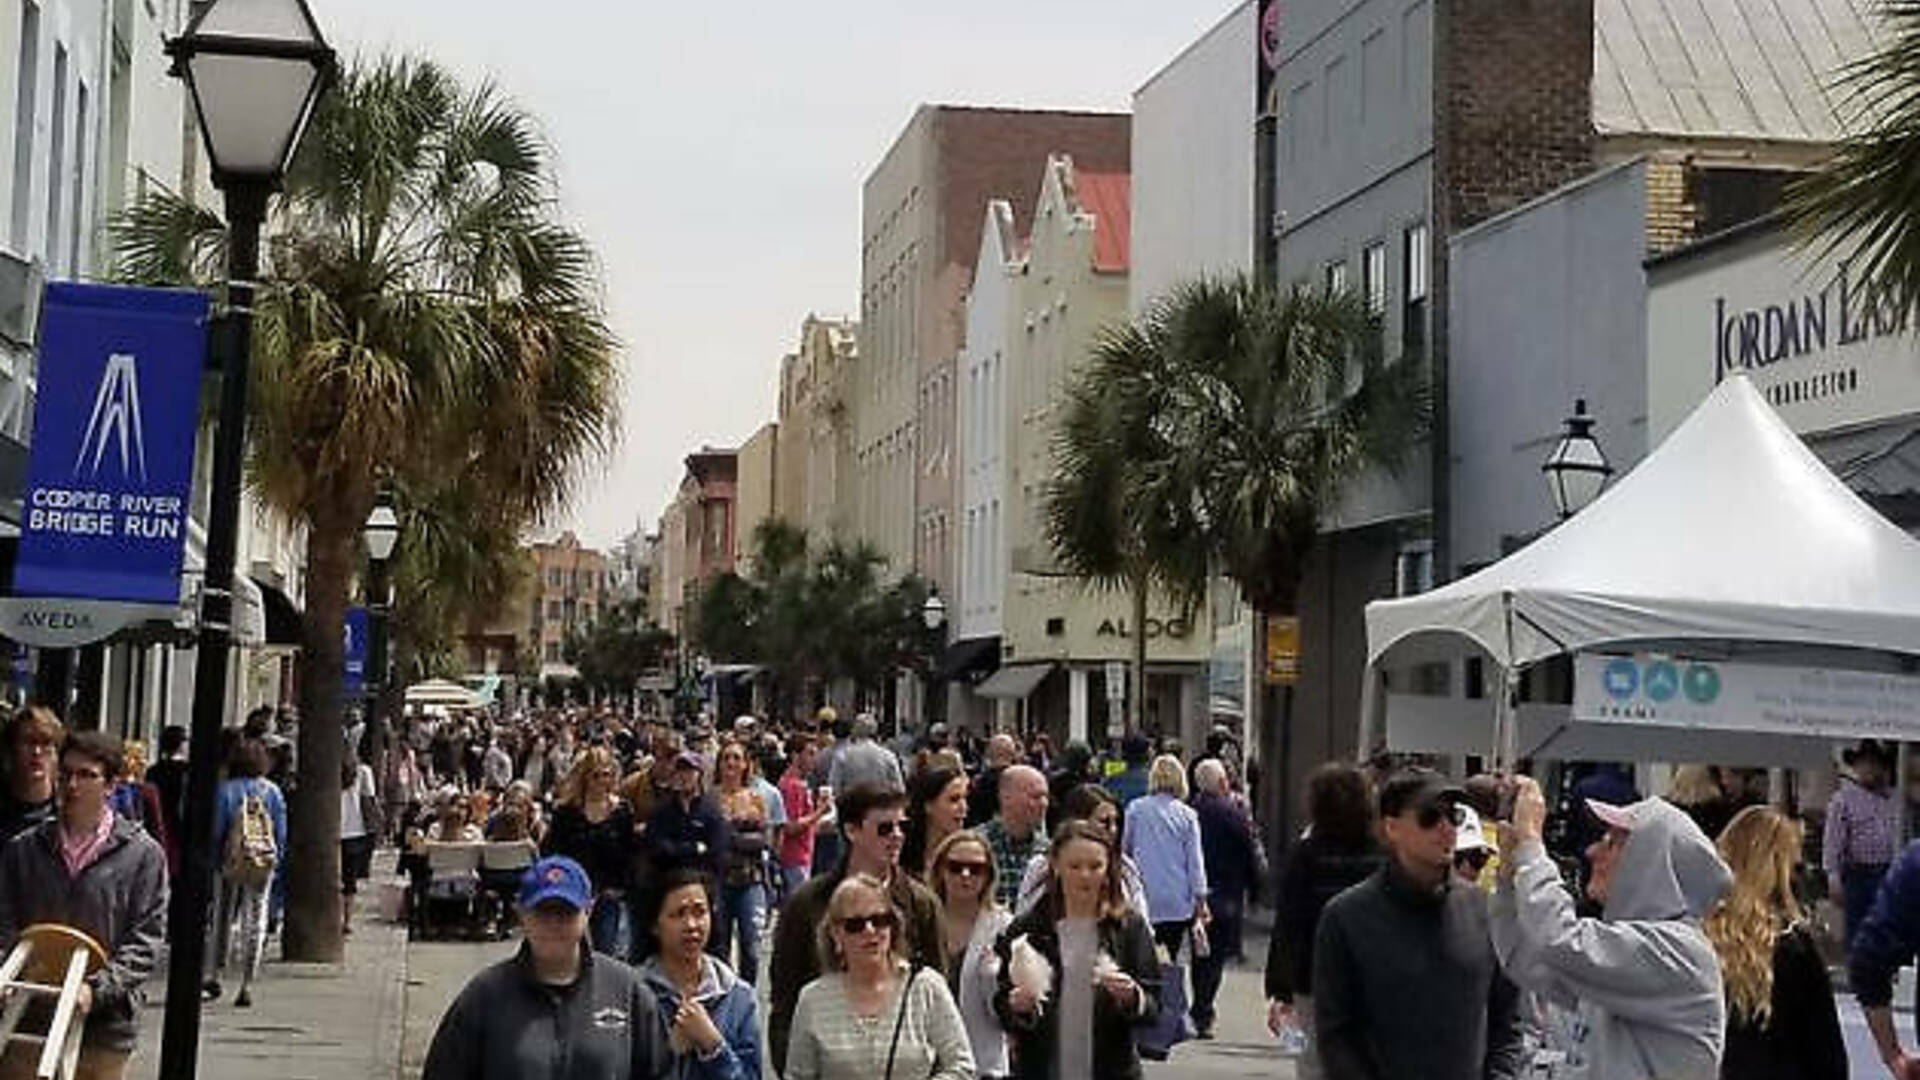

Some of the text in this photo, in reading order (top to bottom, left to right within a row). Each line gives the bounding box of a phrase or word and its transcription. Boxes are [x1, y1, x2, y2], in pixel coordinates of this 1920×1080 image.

[1716, 293, 1826, 386] JORDAN
[32, 488, 181, 516] COOPER RIVER
[29, 508, 180, 538] BRIDGE RUN
